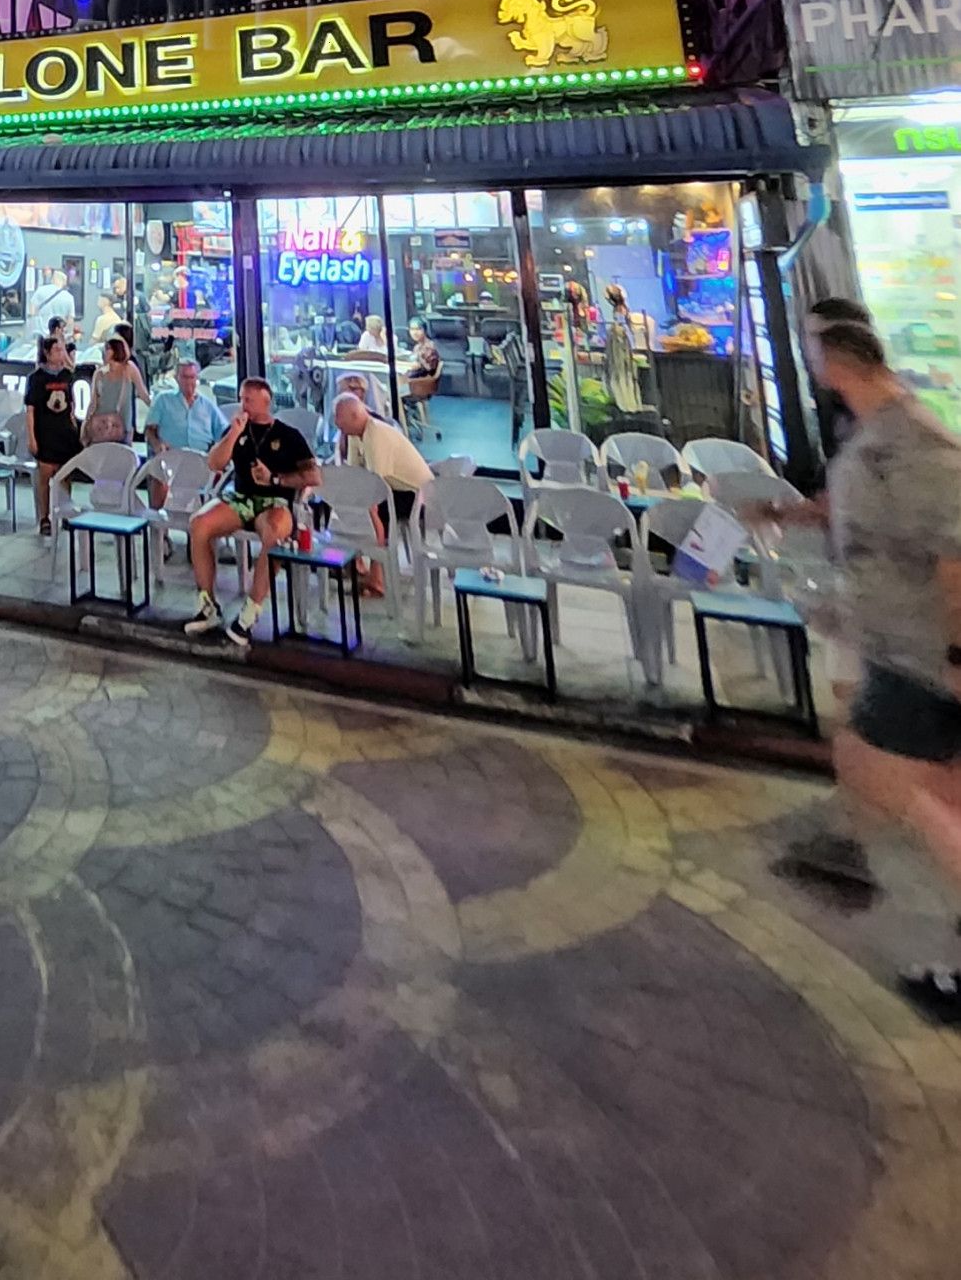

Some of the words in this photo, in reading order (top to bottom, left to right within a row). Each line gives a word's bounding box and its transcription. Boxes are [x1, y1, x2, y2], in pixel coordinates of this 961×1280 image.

[235, 10, 438, 84] BAR
[284, 222, 336, 252] Nail
[278, 251, 371, 287] Eyelash
